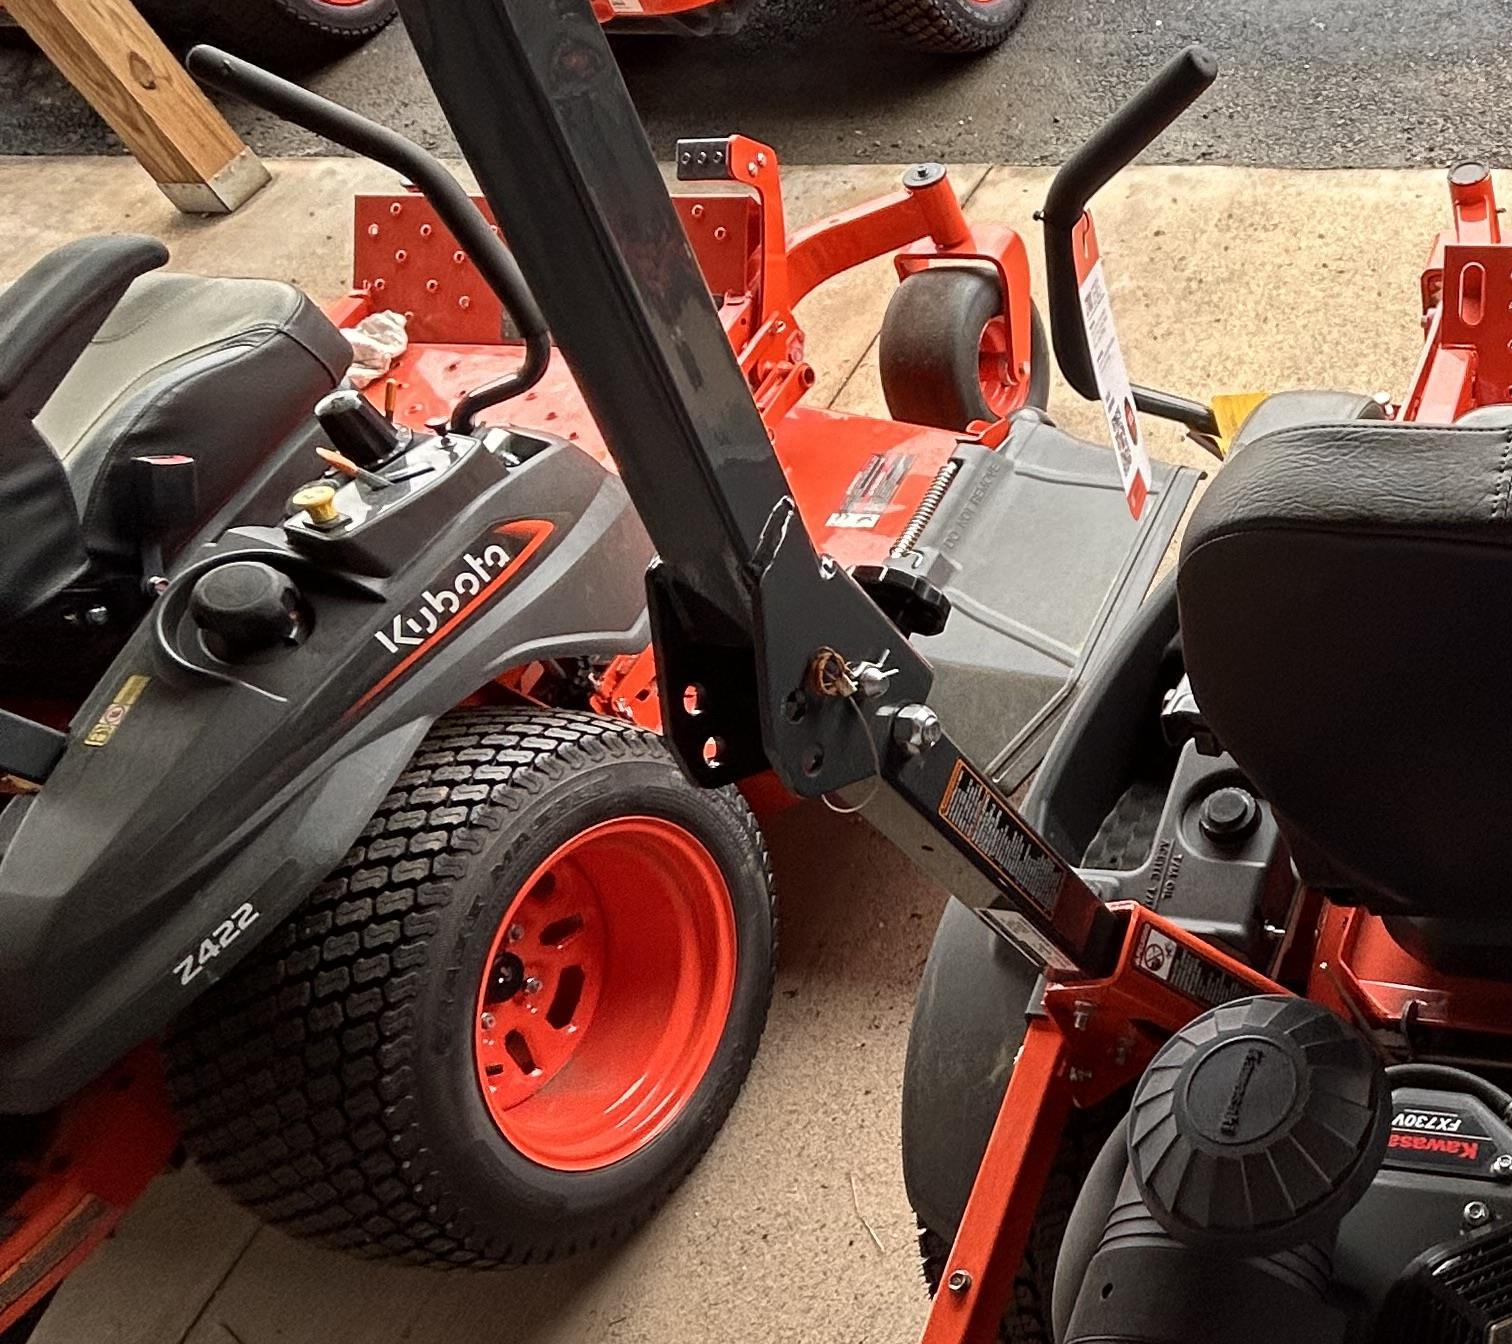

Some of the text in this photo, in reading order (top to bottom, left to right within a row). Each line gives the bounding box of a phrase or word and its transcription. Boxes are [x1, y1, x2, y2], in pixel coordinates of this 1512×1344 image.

[374, 544, 511, 654] Kubota
[172, 902, 260, 986] Z422
[1387, 1133, 1480, 1161] Kawasa
[1390, 1112, 1462, 1132] FX730V
